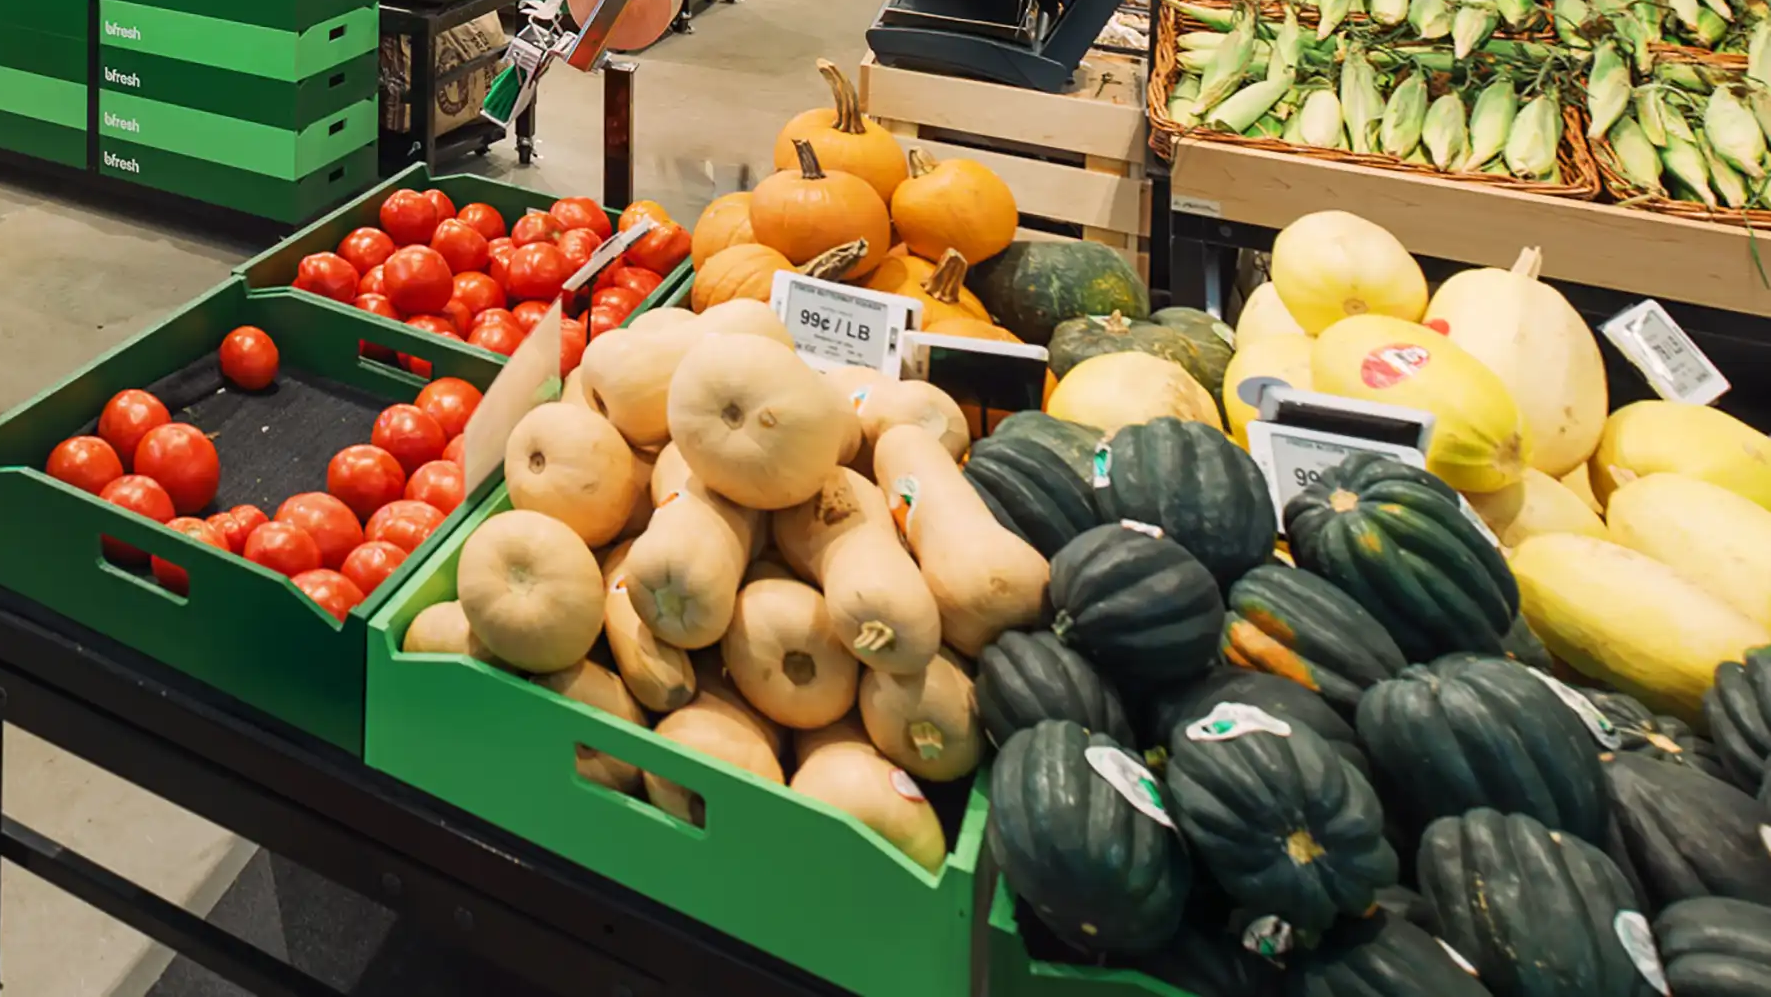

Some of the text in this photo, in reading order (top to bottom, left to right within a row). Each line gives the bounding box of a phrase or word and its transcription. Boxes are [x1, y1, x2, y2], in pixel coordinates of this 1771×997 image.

[105, 21, 141, 41] bfresh
[104, 66, 140, 88] bfresh
[103, 112, 140, 133] bfresh
[103, 151, 140, 174] bfresh
[800, 309, 871, 343] 99¢ / LB
